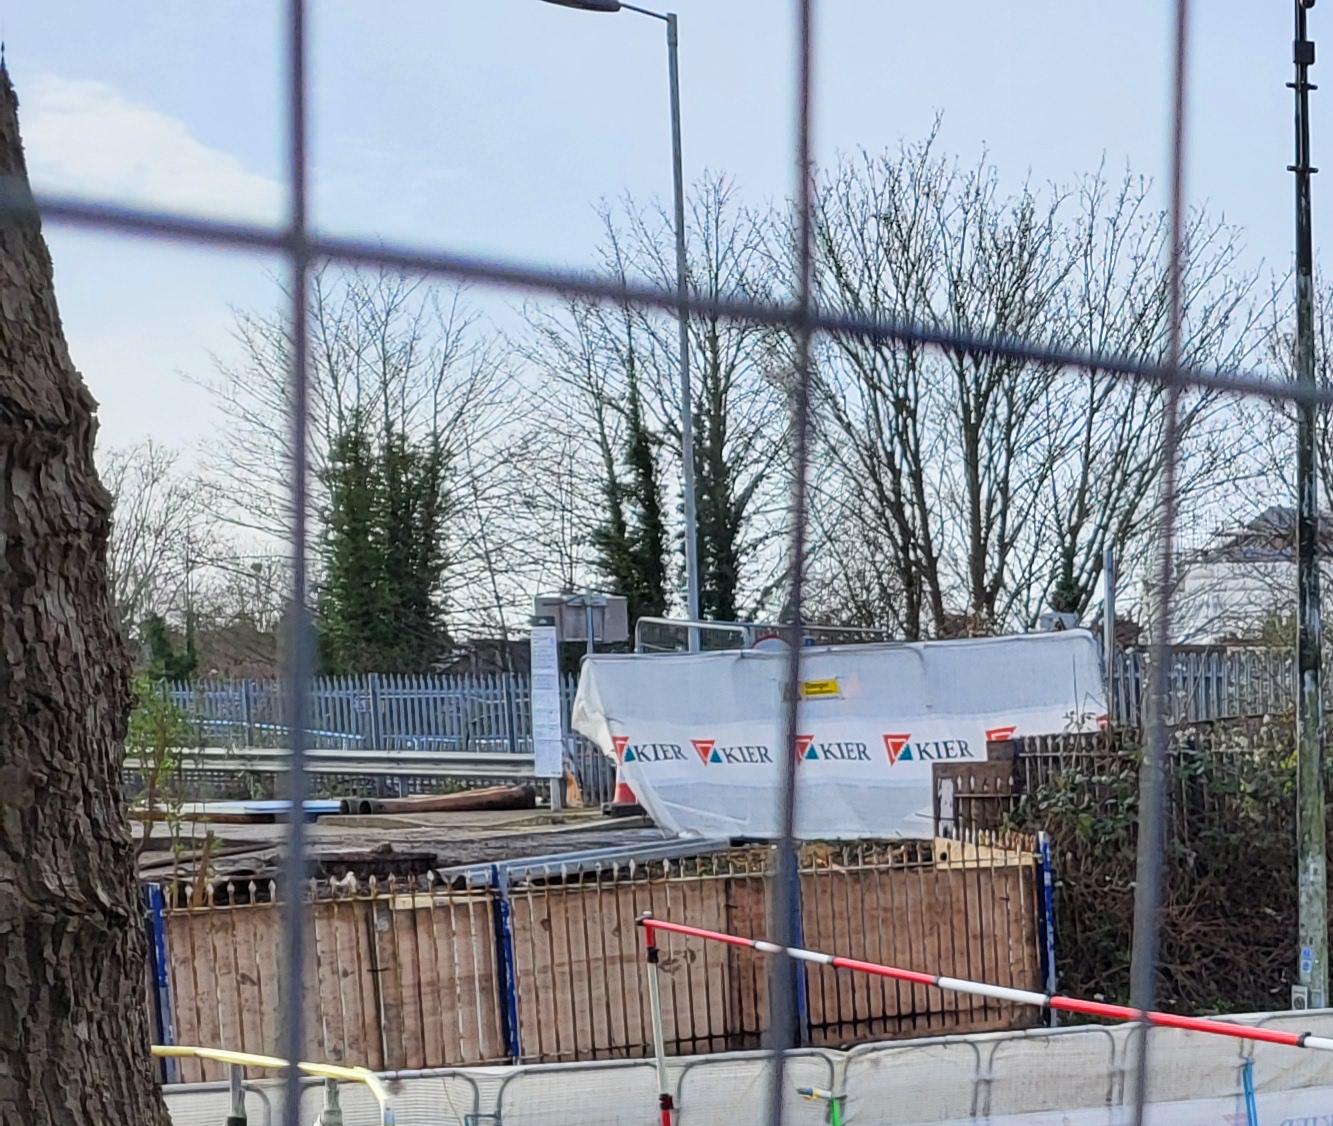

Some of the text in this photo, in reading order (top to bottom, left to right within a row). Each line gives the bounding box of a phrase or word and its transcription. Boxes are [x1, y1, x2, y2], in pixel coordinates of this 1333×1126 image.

[634, 743, 688, 762] KIER
[721, 745, 773, 763] KIER
[819, 742, 871, 761] KIER
[914, 739, 974, 761] KIER
